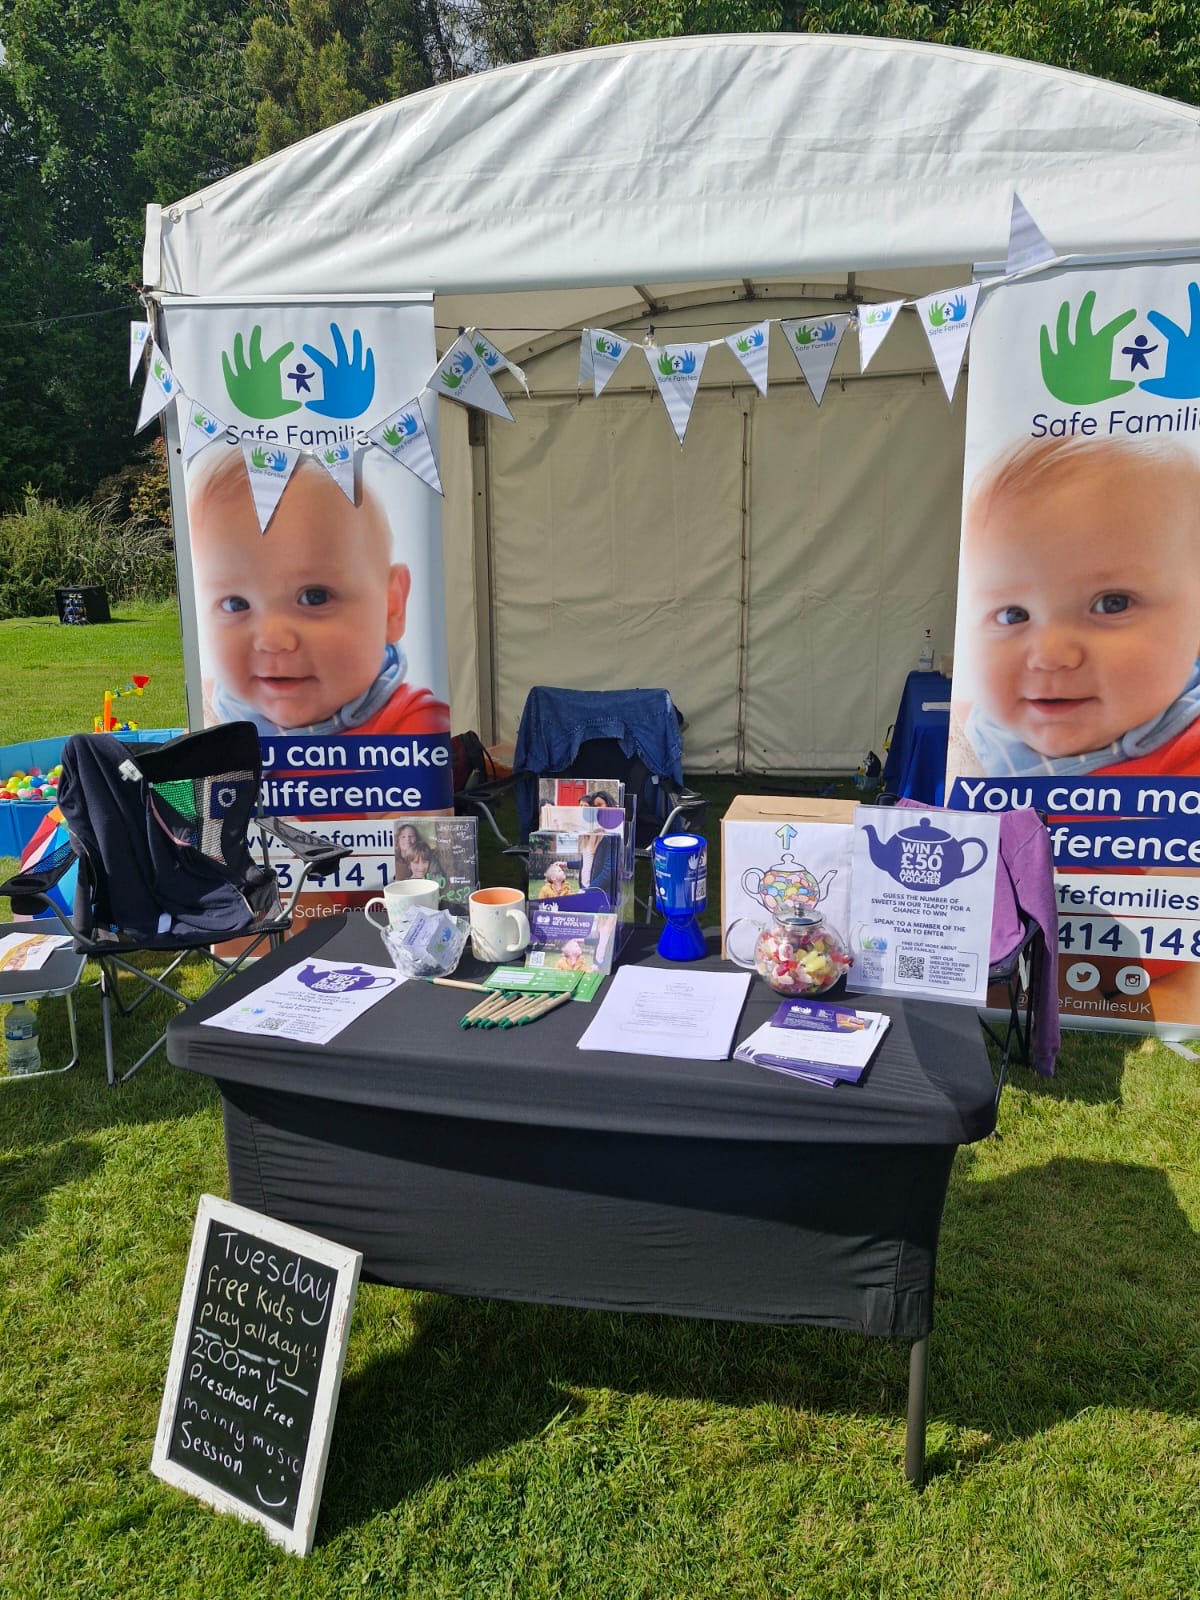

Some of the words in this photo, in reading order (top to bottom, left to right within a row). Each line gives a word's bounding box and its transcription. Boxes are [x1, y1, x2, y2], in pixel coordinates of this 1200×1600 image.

[1031, 411, 1098, 438] Safe
[1108, 406, 1200, 435] Famili
[286, 745, 347, 767] can
[359, 741, 449, 767] make
[960, 780, 1033, 811] You
[1046, 787, 1122, 813] can
[901, 842, 931, 855] WIN
[933, 844, 945, 855] A
[1047, 827, 1200, 863] ference
[899, 868, 942, 879] AMAZON
[900, 853, 943, 871] £50
[899, 875, 942, 885] VOUCHER
[871, 898, 897, 906] SWEETS
[923, 902, 949, 910] TEAPOT
[882, 892, 905, 900] GUESS
[919, 896, 948, 904] NUMBER
[892, 906, 921, 915] CHANCE
[1055, 884, 1200, 911] fefamilies
[873, 918, 895, 926] SPEAK
[913, 922, 941, 930] MEMBER
[893, 926, 912, 934] TEAM
[923, 929, 944, 937] ENTER
[1058, 921, 1123, 952] 414
[218, 1232, 331, 1326] Tuesday
[189, 1362, 258, 1412] Preschool
[180, 1420, 243, 1476] Session
[252, 1434, 300, 1473] music
